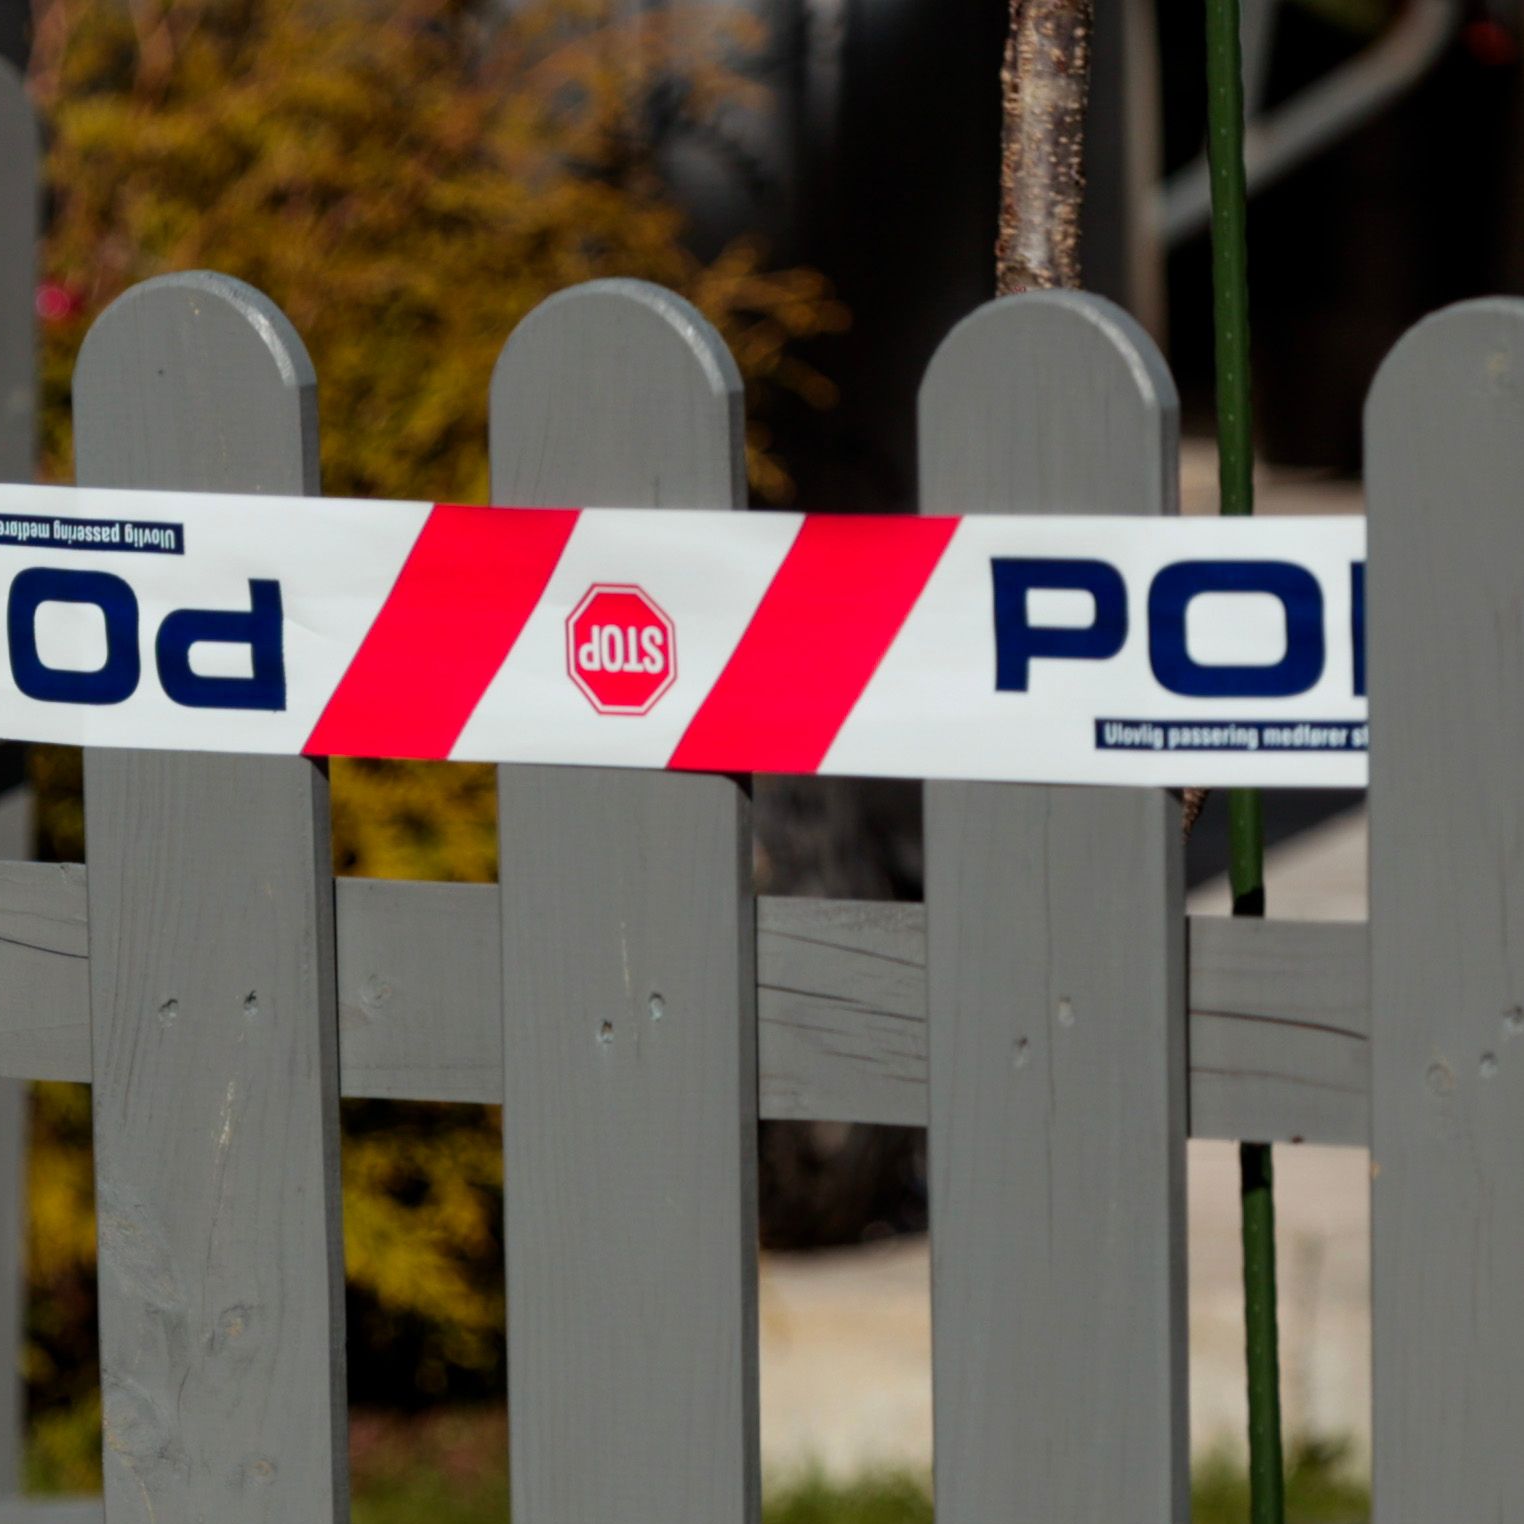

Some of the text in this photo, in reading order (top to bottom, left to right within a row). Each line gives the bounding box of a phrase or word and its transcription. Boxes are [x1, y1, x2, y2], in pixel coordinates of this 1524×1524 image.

[53, 519, 120, 544] passering
[124, 523, 176, 550] Ulovlig
[990, 557, 1366, 698] PO
[579, 624, 665, 674] STOP
[1104, 722, 1164, 750] Ulovlig
[1168, 724, 1258, 751] passering
